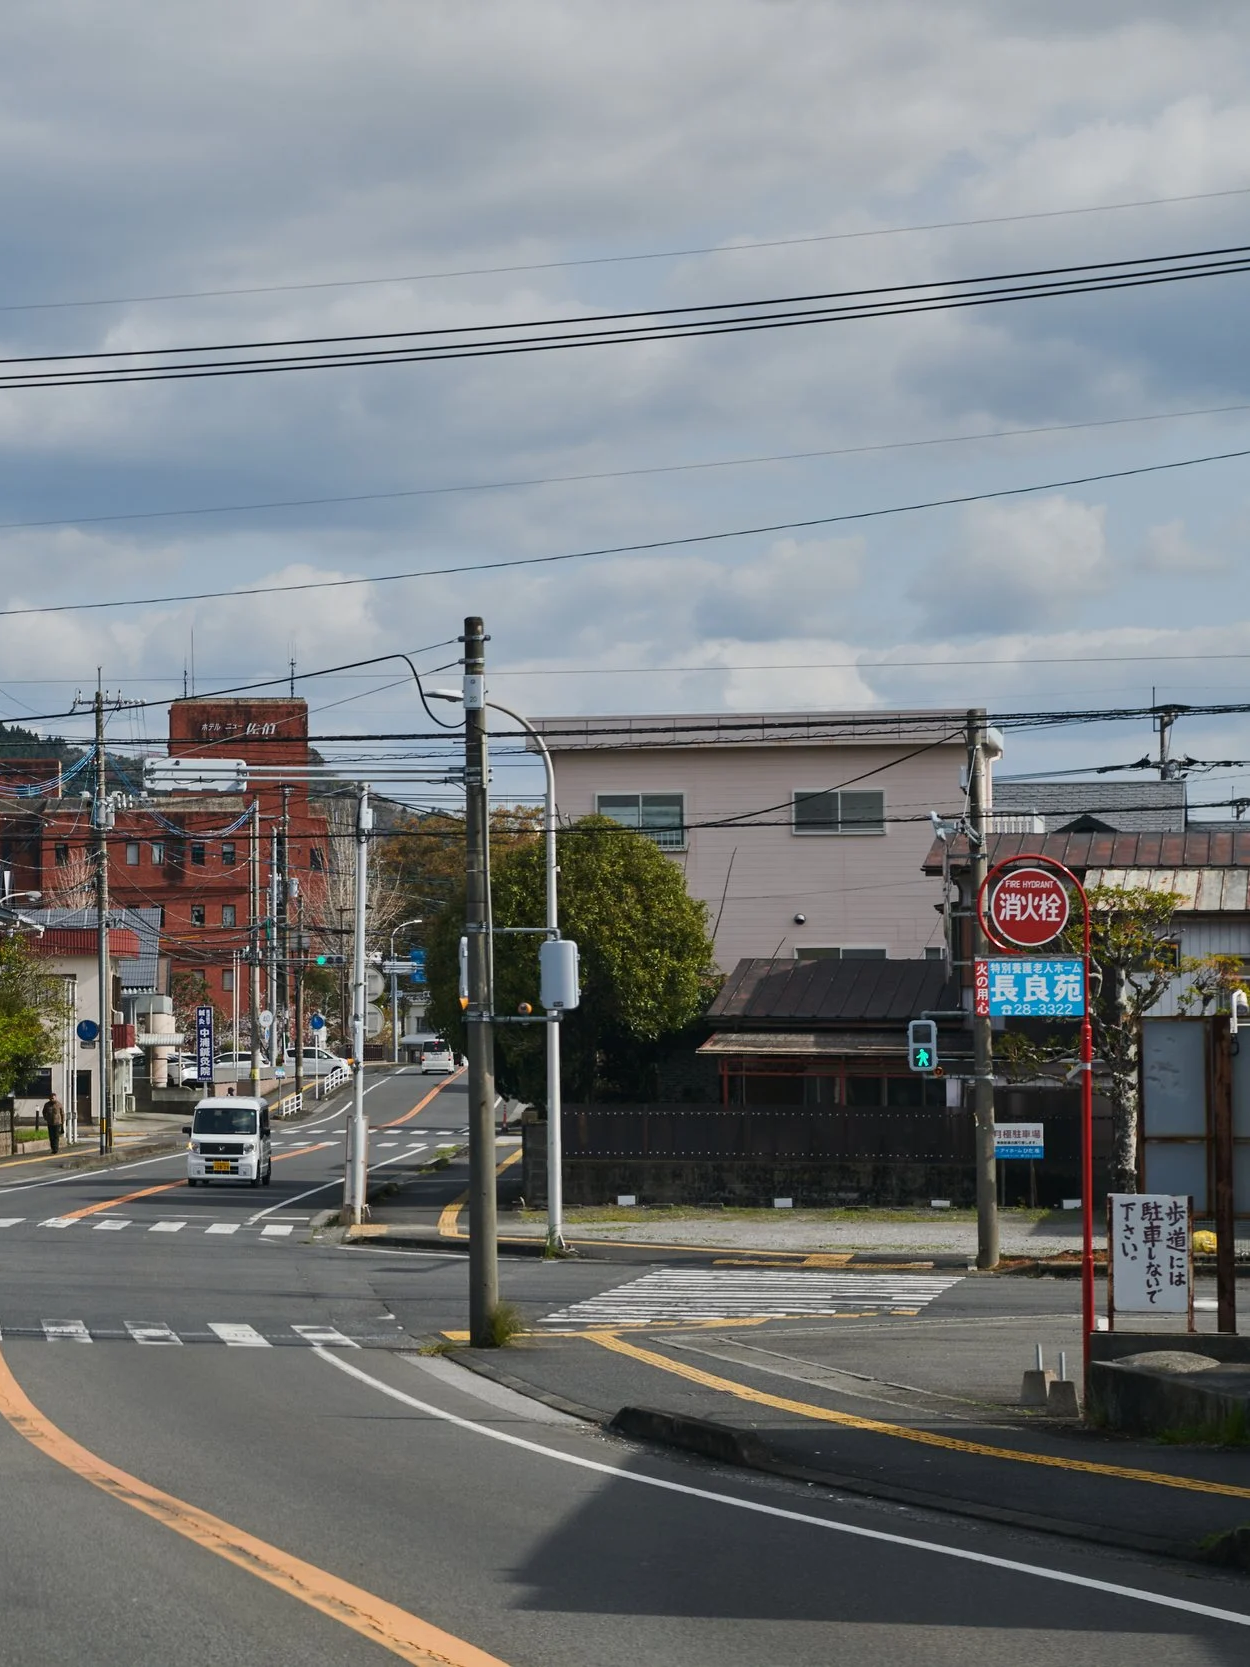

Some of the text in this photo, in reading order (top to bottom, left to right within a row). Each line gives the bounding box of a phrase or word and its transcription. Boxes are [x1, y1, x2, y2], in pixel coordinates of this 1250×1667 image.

[201, 723, 221, 731] ホテル
[1005, 880, 1054, 889] FIRE HYDRANT
[999, 893, 1062, 922] 消火栓
[990, 962, 1082, 974] 特別養護老人ホーム
[976, 963, 990, 1015] 火の用心
[990, 974, 1083, 1004] 長良苑
[1014, 1004, 1073, 1015] 28-3322
[1120, 1202, 1138, 1261] 下さい。
[1165, 1201, 1186, 1287] 歩道には
[1140, 1201, 1164, 1304] 駐車しないで
